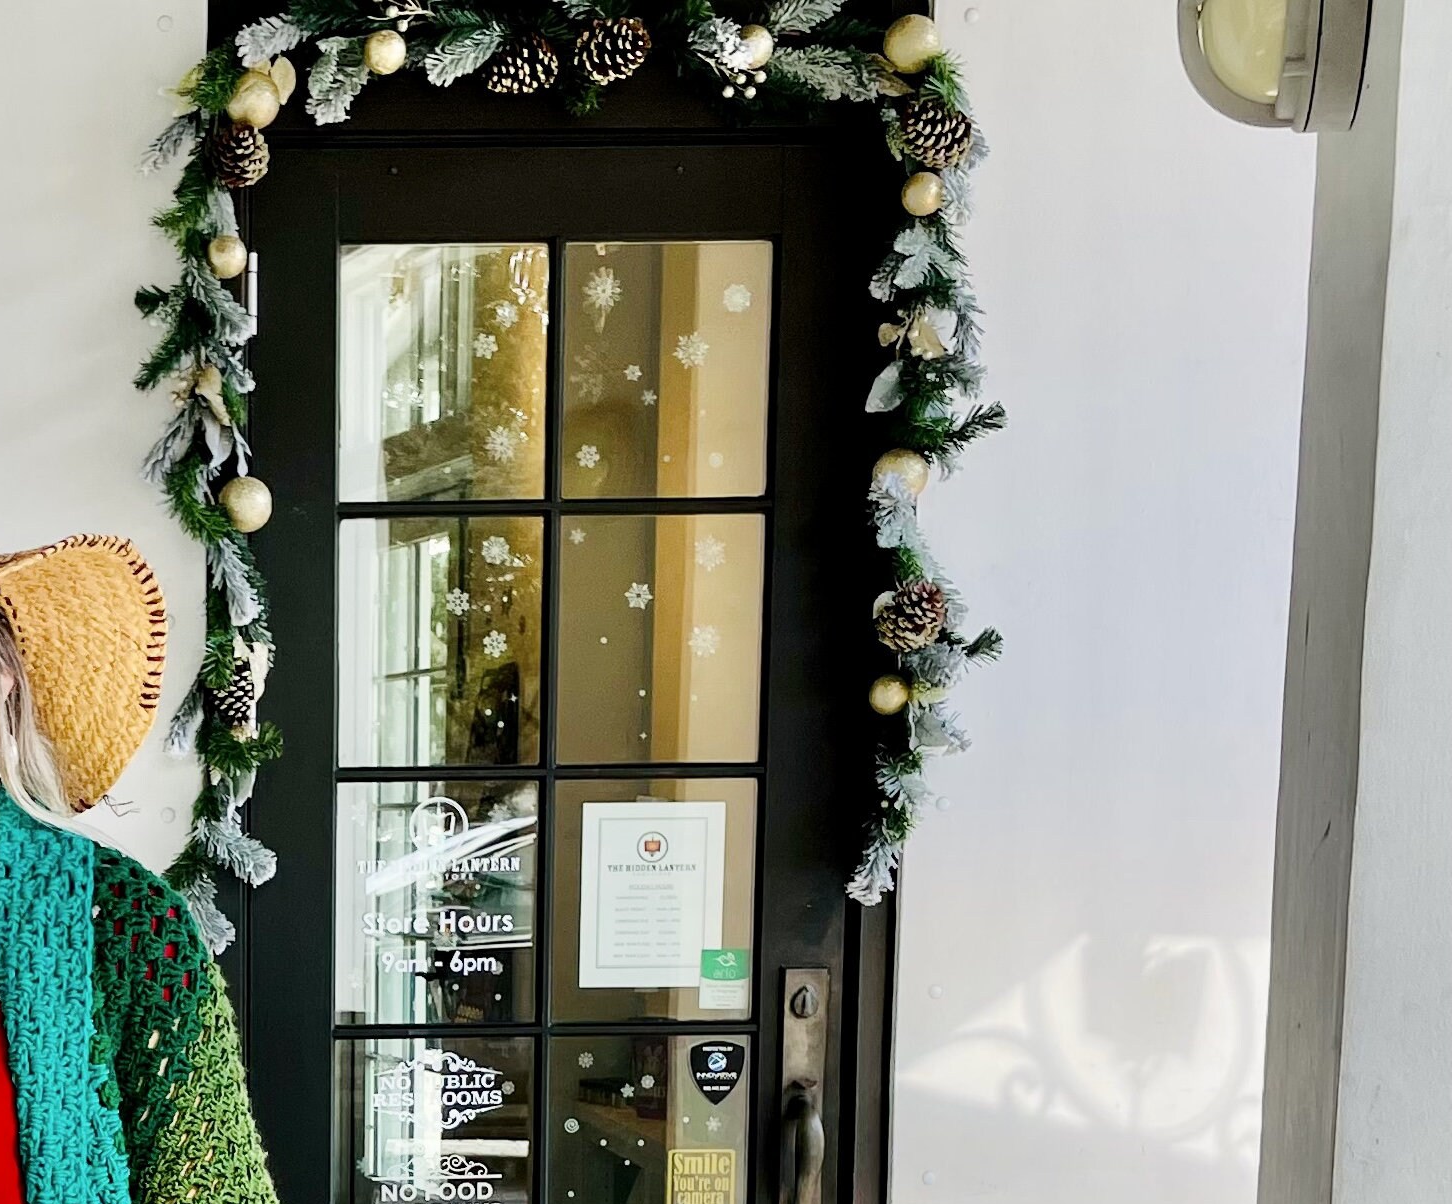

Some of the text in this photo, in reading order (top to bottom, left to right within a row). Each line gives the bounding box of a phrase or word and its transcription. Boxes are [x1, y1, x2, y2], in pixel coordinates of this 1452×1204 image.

[452, 856, 521, 872] LANTERN
[607, 863, 697, 873] THE HIDDEN LANTERN
[362, 910, 514, 936] Store Hours
[381, 951, 428, 974] 9am
[449, 950, 497, 976] 6pm
[379, 1074, 496, 1091] NO UBLIC
[373, 1089, 503, 1107] RESOOMS
[673, 1153, 731, 1175] Smile
[380, 1183, 418, 1202] NO
[673, 1175, 730, 1192] You're on
